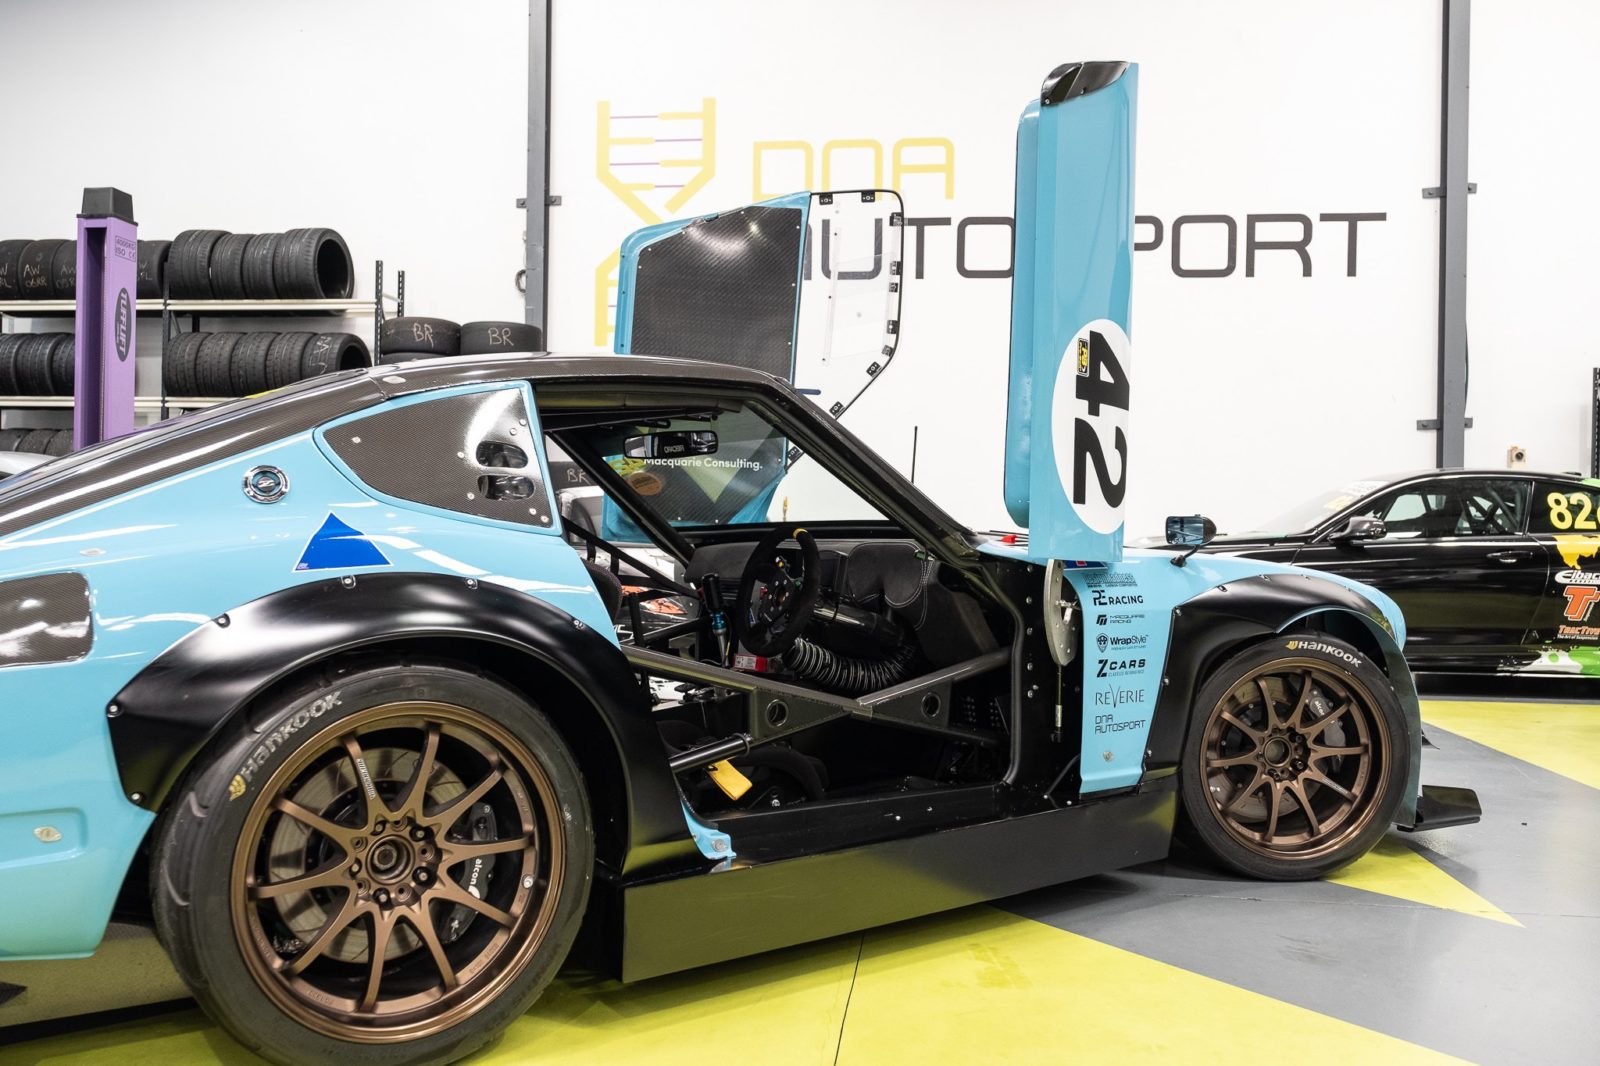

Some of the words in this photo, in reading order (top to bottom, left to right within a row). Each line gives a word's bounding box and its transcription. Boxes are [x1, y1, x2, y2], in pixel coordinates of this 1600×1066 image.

[119, 291, 128, 356] TUFFLIFT
[412, 322, 434, 348] BR
[487, 327, 515, 347] BR
[1073, 330, 1130, 508] 42
[643, 457, 703, 469] Macquarie
[703, 456, 764, 471] Consulting.
[1547, 491, 1600, 531] 82
[1555, 570, 1600, 584] Eibac
[1108, 595, 1145, 606] RACING
[1109, 658, 1147, 671] CARS
[1095, 683, 1145, 708] REVERIE
[1095, 719, 1146, 735] AUTOSPORT
[469, 858, 483, 885] alcon
